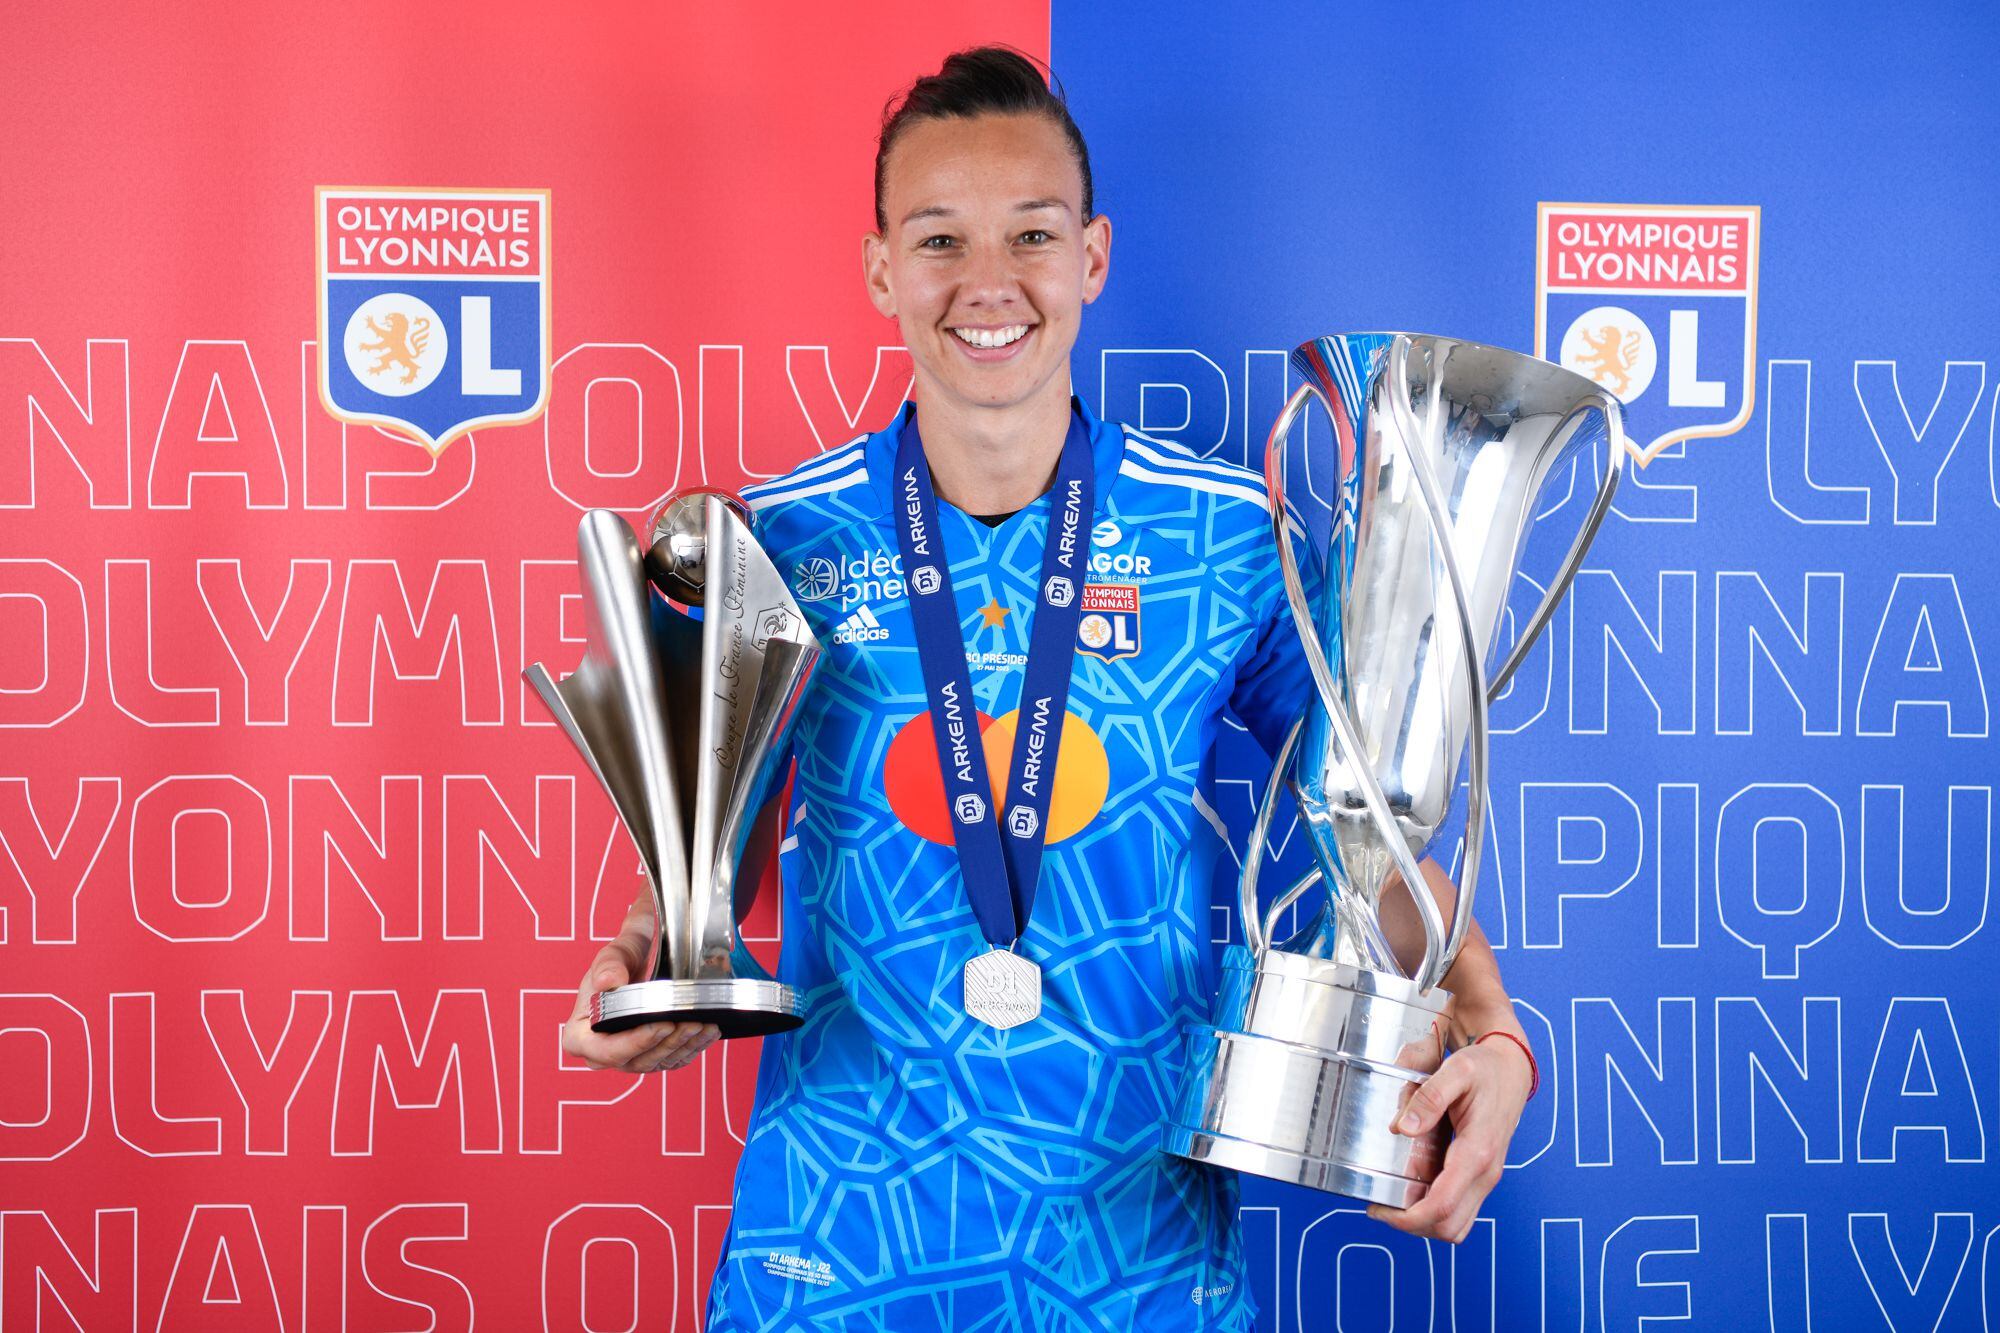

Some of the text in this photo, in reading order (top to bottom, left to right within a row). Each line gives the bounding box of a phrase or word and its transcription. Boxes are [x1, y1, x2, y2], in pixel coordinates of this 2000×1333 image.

[337, 206, 530, 236] OLYMPIQUE
[1557, 222, 1739, 251] OLYMPIQUE
[338, 237, 530, 268] LYONNAIS
[1557, 253, 1738, 284] LYONNAIS
[904, 466, 931, 556] ARKEMA
[1056, 479, 1083, 569] ARKEMA
[917, 570, 934, 590] D1
[1051, 582, 1066, 601] D1
[833, 627, 889, 645] adidas
[719, 623, 743, 688] France
[941, 680, 974, 783] ARKEMA
[1021, 696, 1052, 797] ARKEMA
[961, 798, 977, 819] D1
[1015, 811, 1030, 832] D1
[769, 1252, 779, 1263] D1
[779, 1254, 811, 1270] ARKEMA
